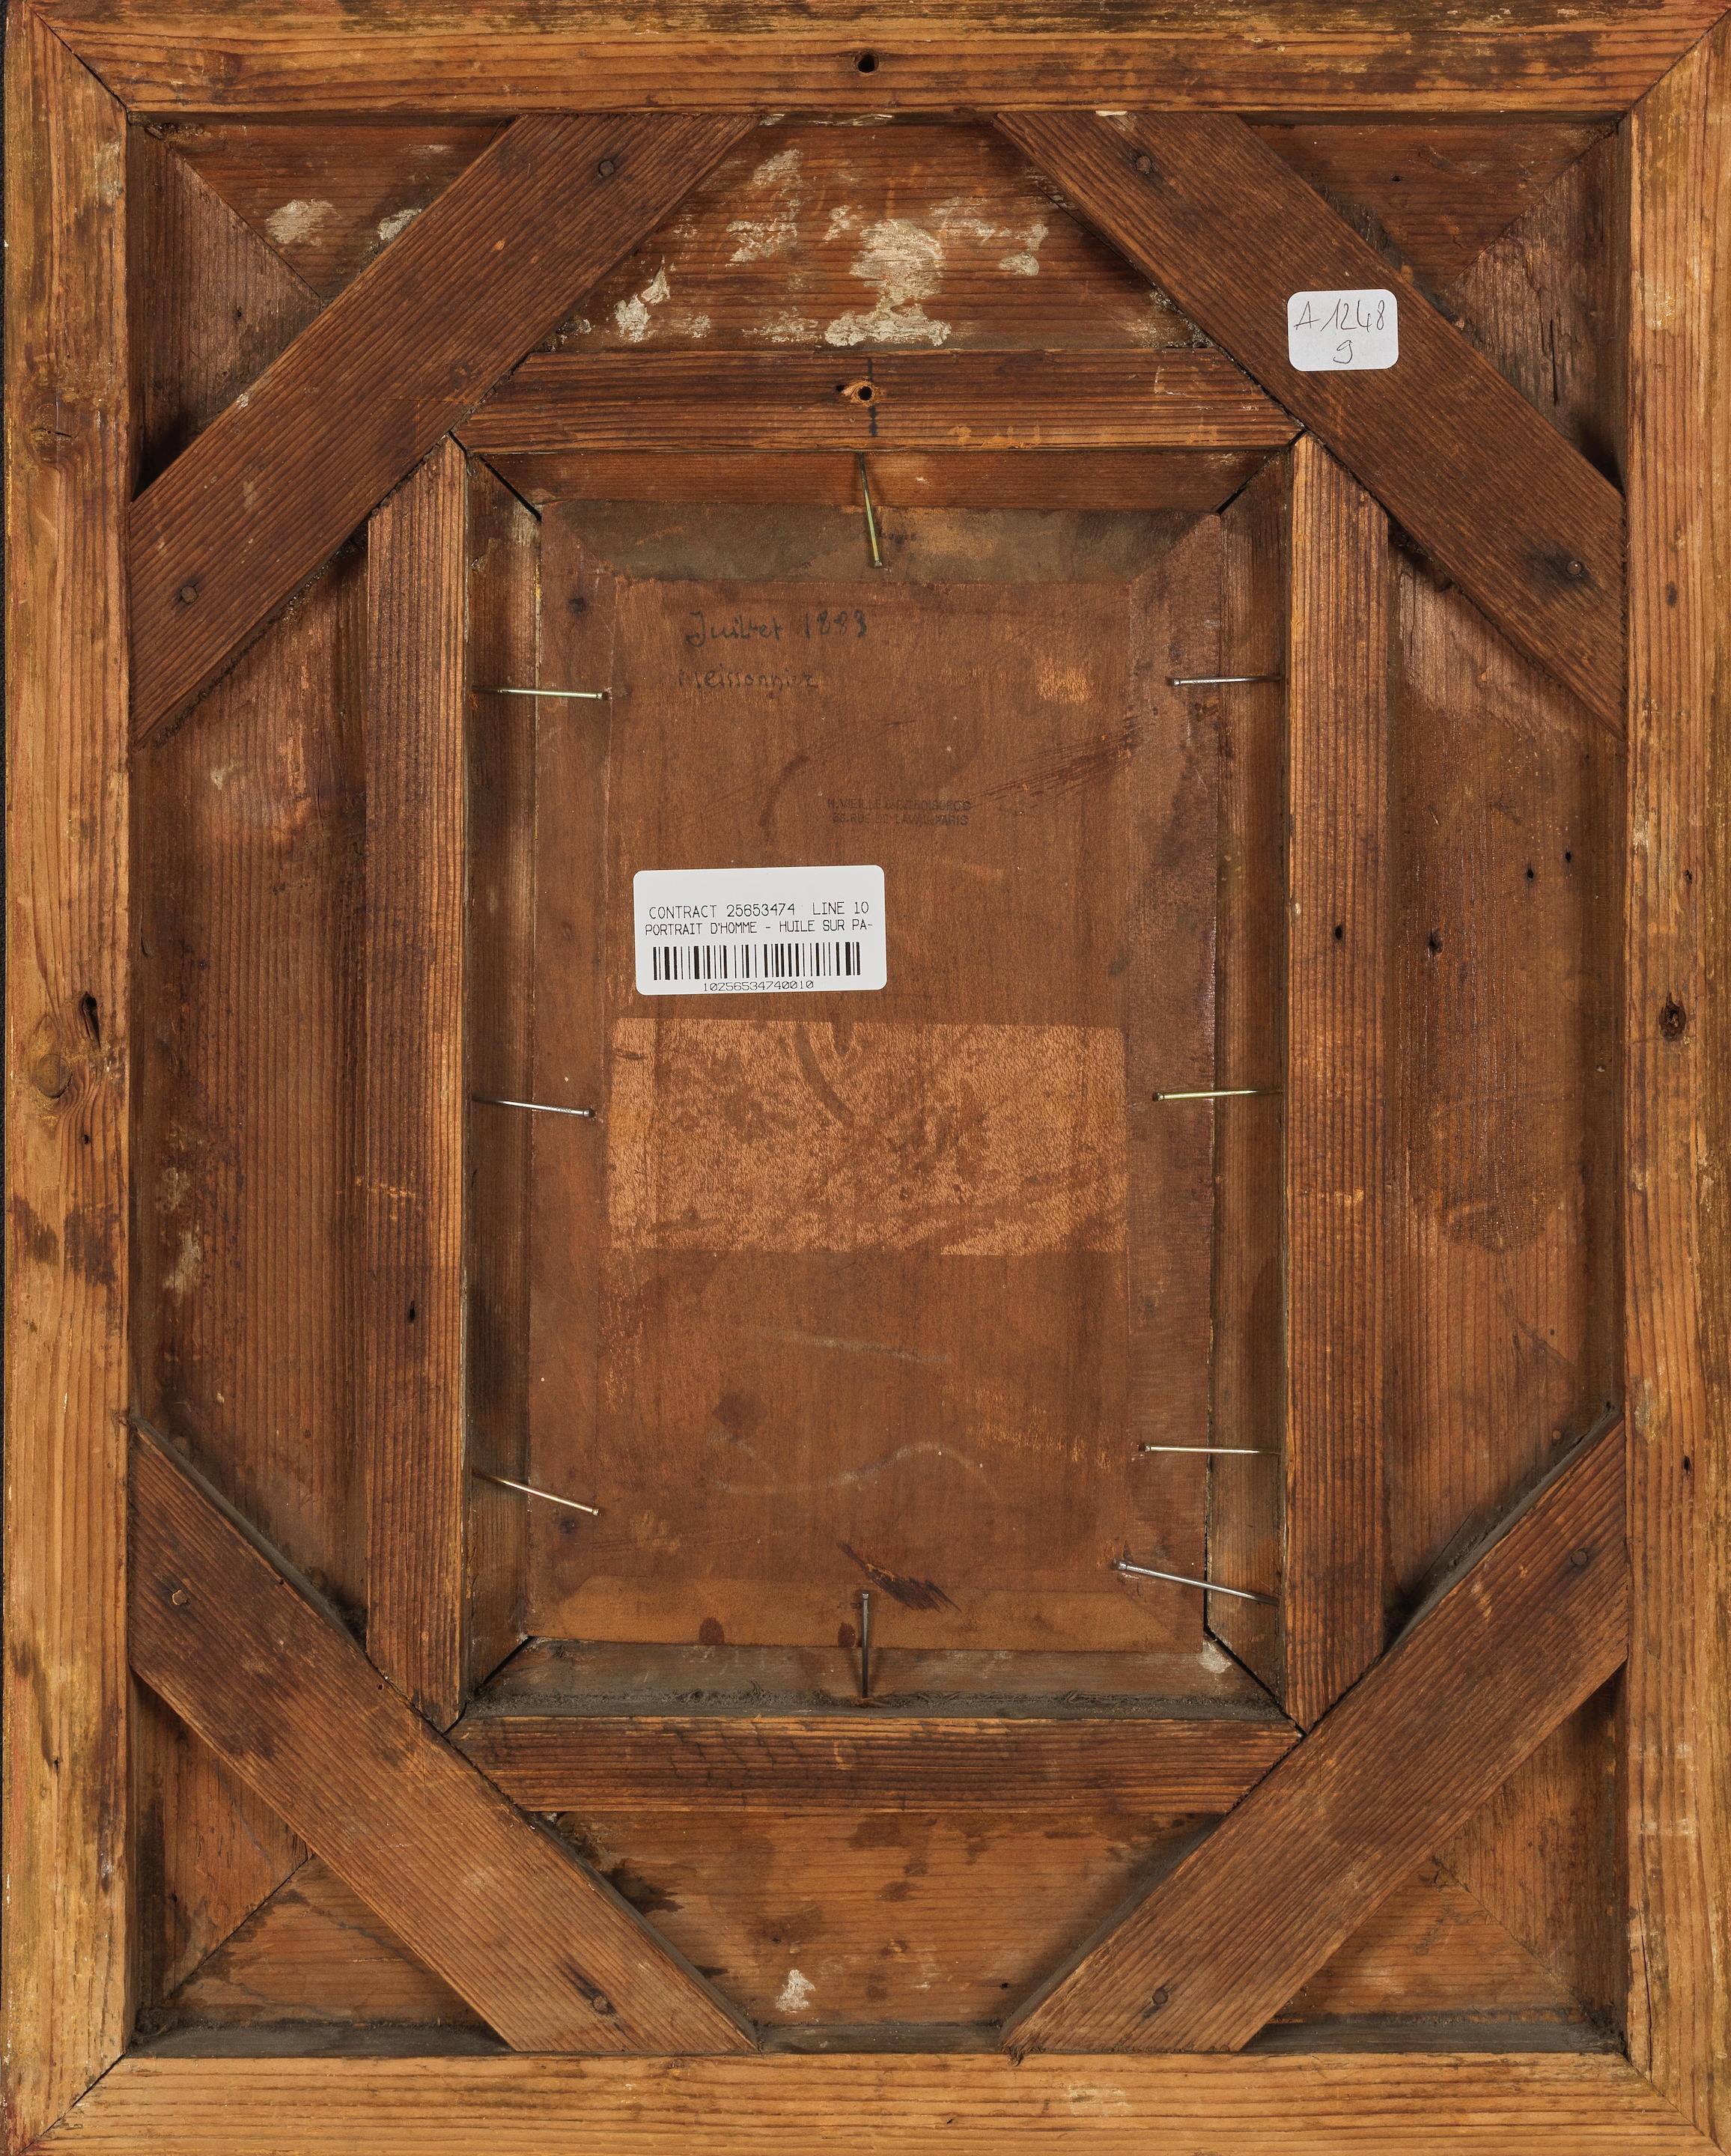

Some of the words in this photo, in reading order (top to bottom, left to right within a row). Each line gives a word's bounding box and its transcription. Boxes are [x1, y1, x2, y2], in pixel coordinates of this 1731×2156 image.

[649, 905, 717, 919] CONTRACT
[727, 904, 794, 917] 25653474
[813, 902, 845, 915] LINE
[854, 901, 868, 914] 10
[645, 923, 702, 935] PORTRAIT
[711, 922, 757, 934] D'HOMME
[779, 920, 815, 932] HUILE
[823, 919, 845, 931] SUR
[853, 919, 872, 931] PA-
[704, 981, 814, 992] 10256534740010
